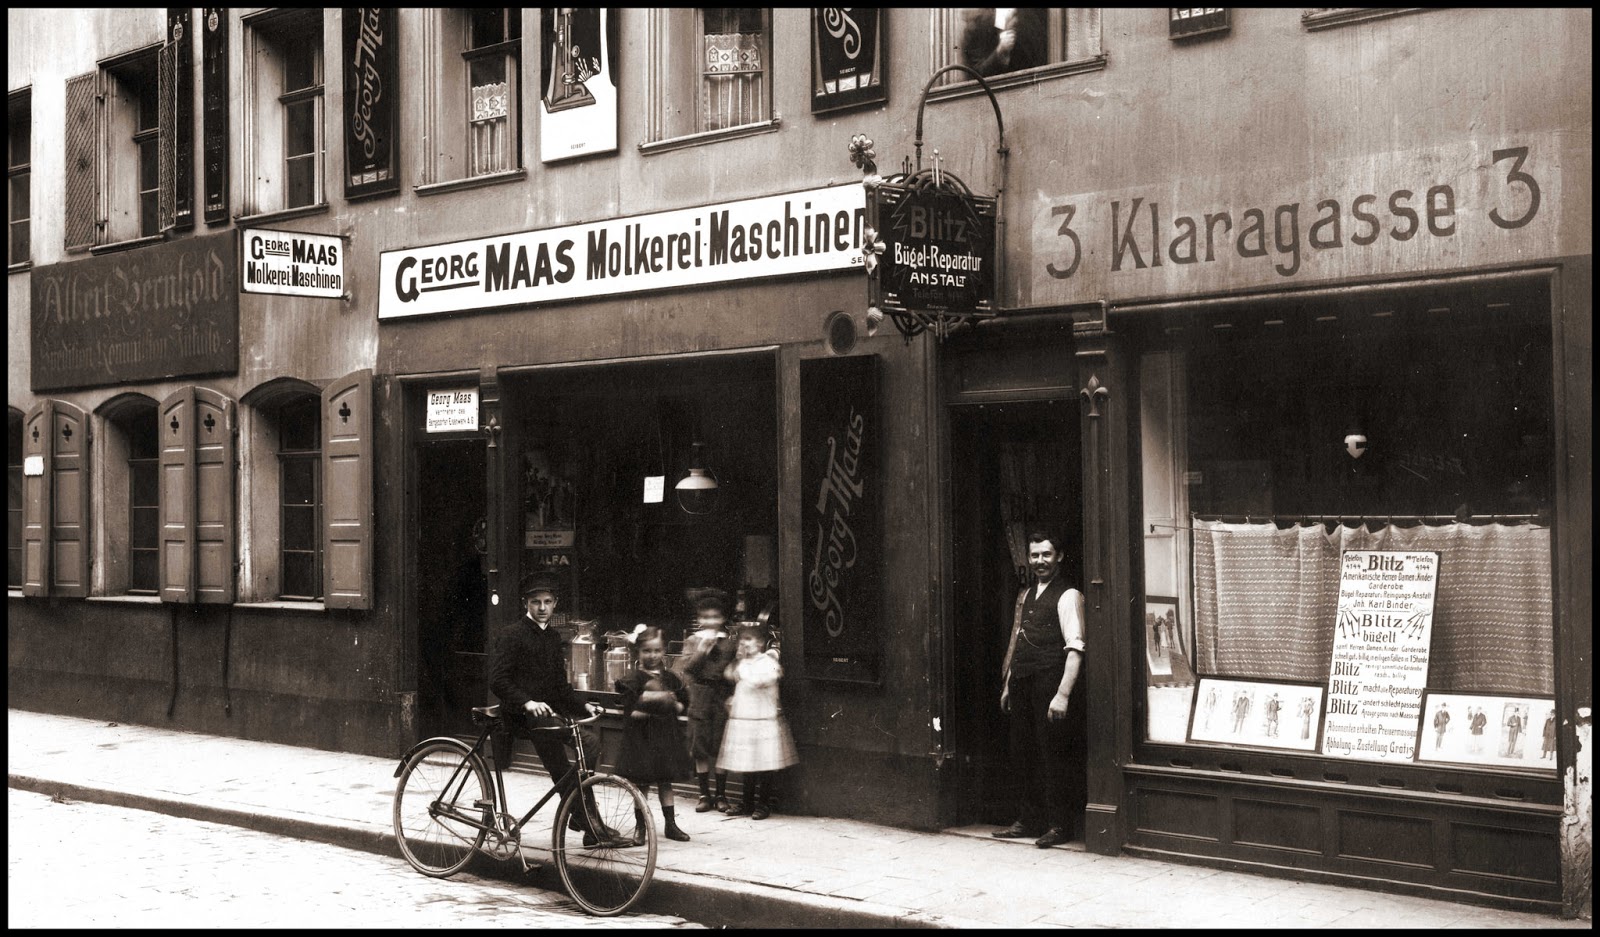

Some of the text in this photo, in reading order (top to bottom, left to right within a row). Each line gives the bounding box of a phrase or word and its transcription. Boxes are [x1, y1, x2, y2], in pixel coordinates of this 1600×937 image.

[1045, 146, 1542, 279] 3 Klaragasse 3
[910, 205, 967, 243] Blitz
[251, 236, 337, 266] GEORG MAAS
[894, 242, 982, 272] Bügel-Reparatur
[395, 252, 480, 303] GEORG
[485, 239, 576, 293] MAAS
[909, 272, 967, 287] ANSTALT
[431, 392, 472, 407] Georg Maas
[809, 405, 864, 638] Georg Maas
[1345, 555, 1363, 564] Telefon
[1412, 555, 1434, 565] Telefon
[1368, 583, 1404, 591] Garderobe
[1368, 600, 1385, 609] Karl
[1386, 600, 1414, 610] Binder
[1361, 613, 1403, 629] Blitz
[1362, 630, 1397, 644] bügelt
[1389, 741, 1416, 760] Gratis
